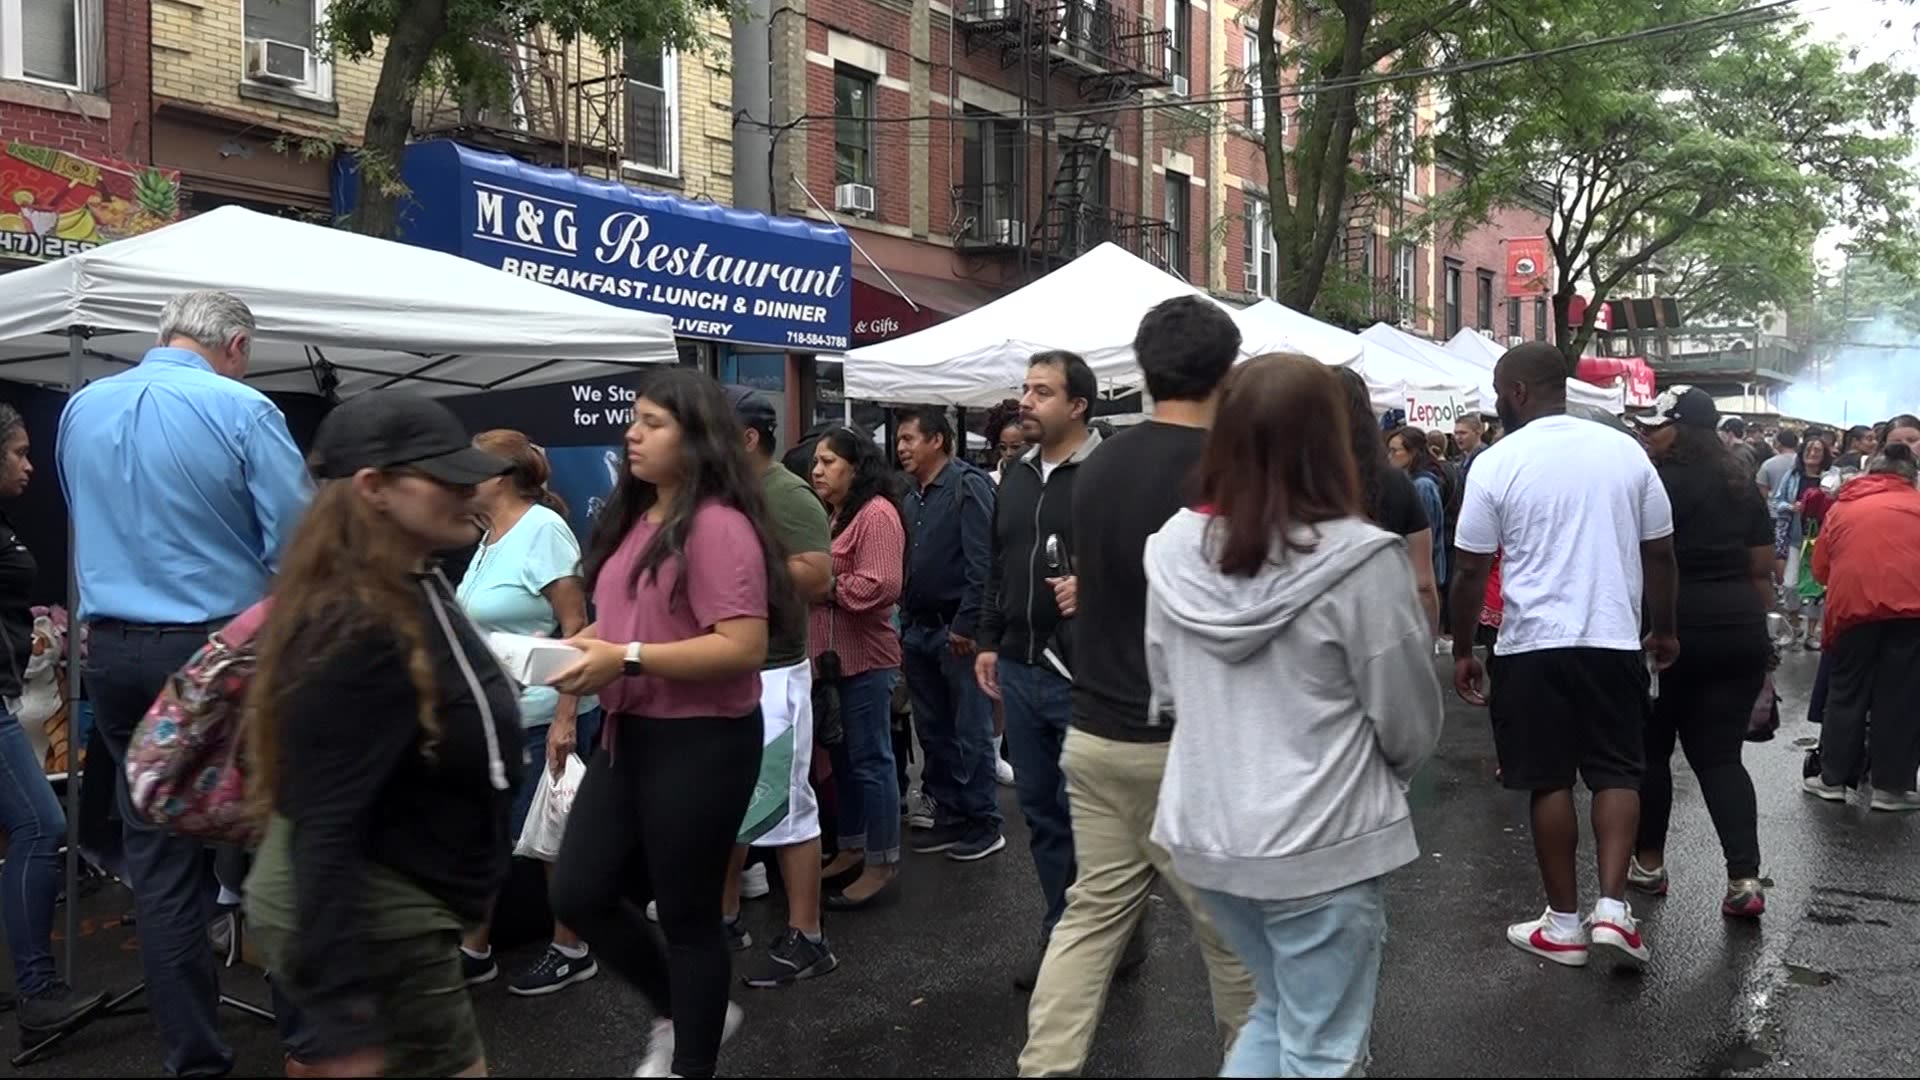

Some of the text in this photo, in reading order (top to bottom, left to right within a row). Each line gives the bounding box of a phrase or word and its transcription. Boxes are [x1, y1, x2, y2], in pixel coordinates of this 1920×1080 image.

[476, 190, 844, 298] M & G Restaurant
[733, 297, 747, 314] &
[753, 299, 828, 323] DINNER
[854, 317, 899, 337] & Gifts
[571, 385, 602, 402] We
[574, 408, 599, 425] for
[1406, 395, 1466, 427] Zeppole
